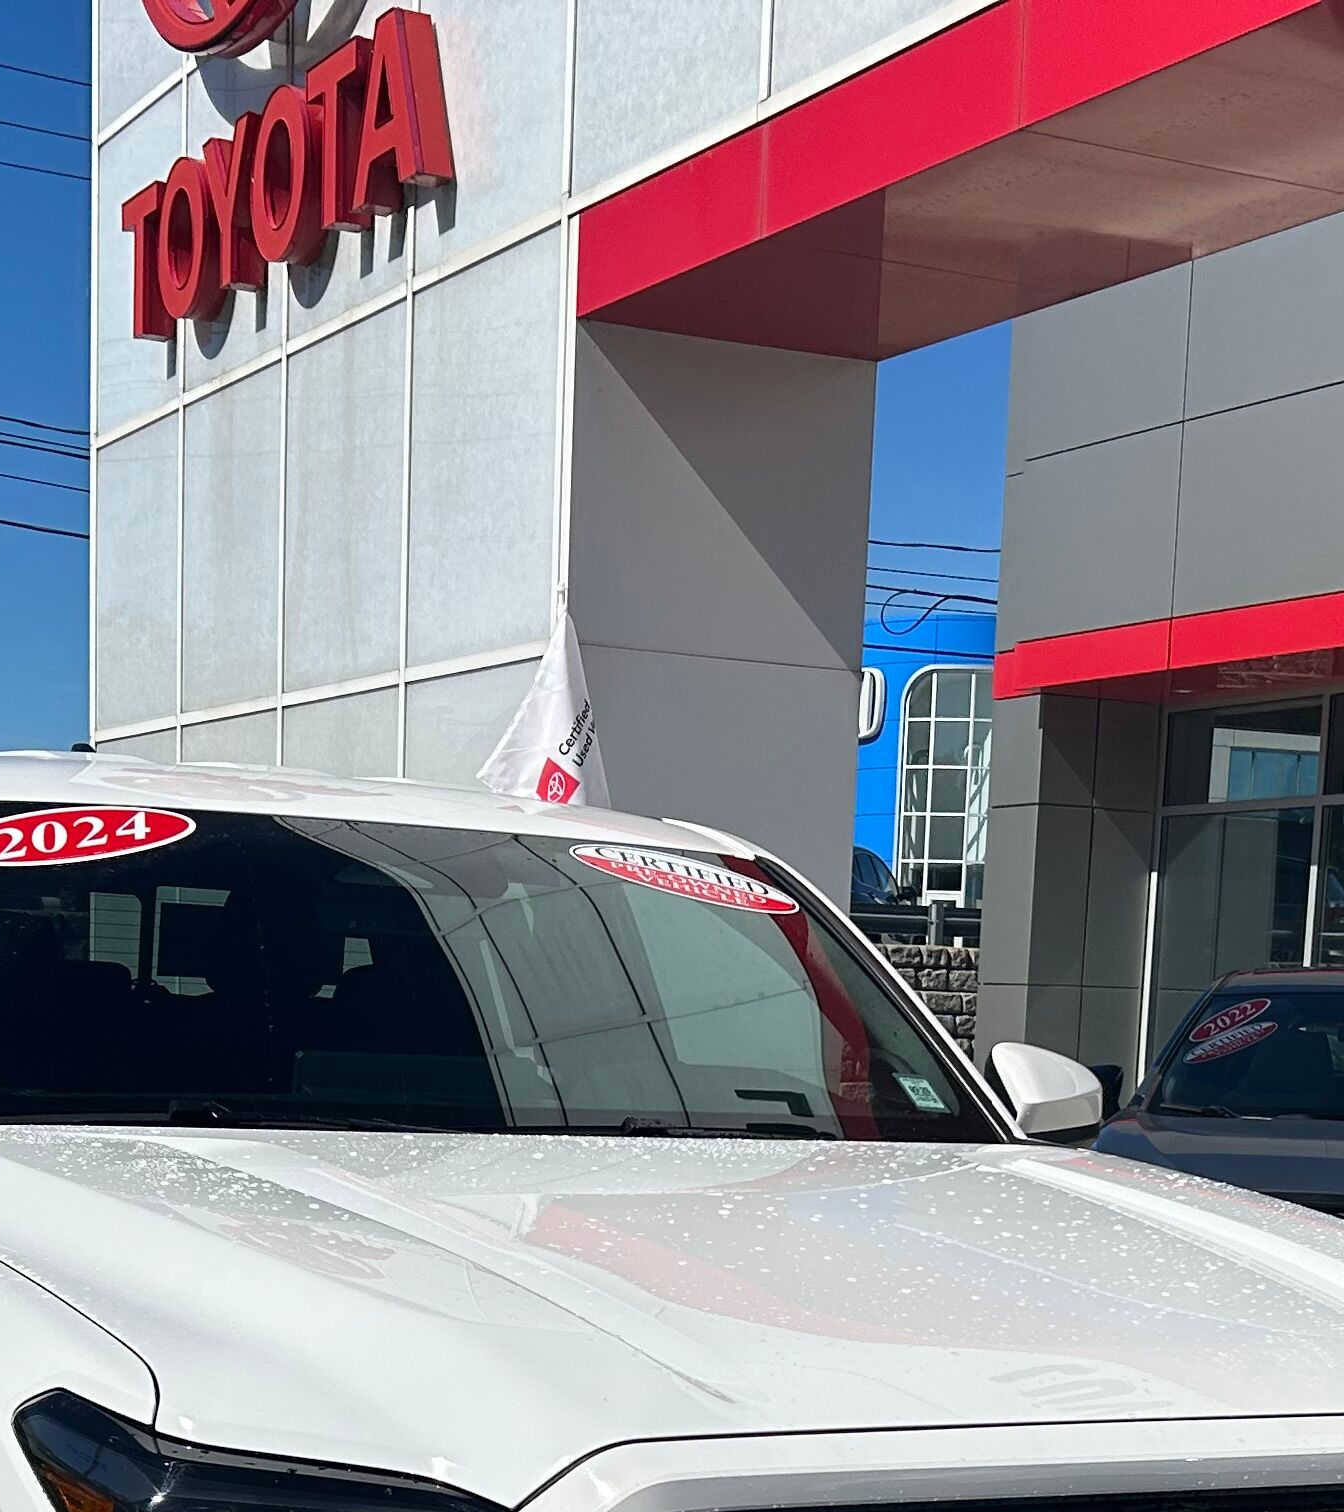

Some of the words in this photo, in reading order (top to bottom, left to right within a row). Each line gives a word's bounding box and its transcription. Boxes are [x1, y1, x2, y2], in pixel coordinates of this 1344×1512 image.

[122, 8, 454, 341] TOYOTA
[558, 698, 591, 756] Certified
[572, 731, 594, 768] Used
[594, 847, 769, 896] CERTIFIED
[1203, 1003, 1256, 1036] 2022
